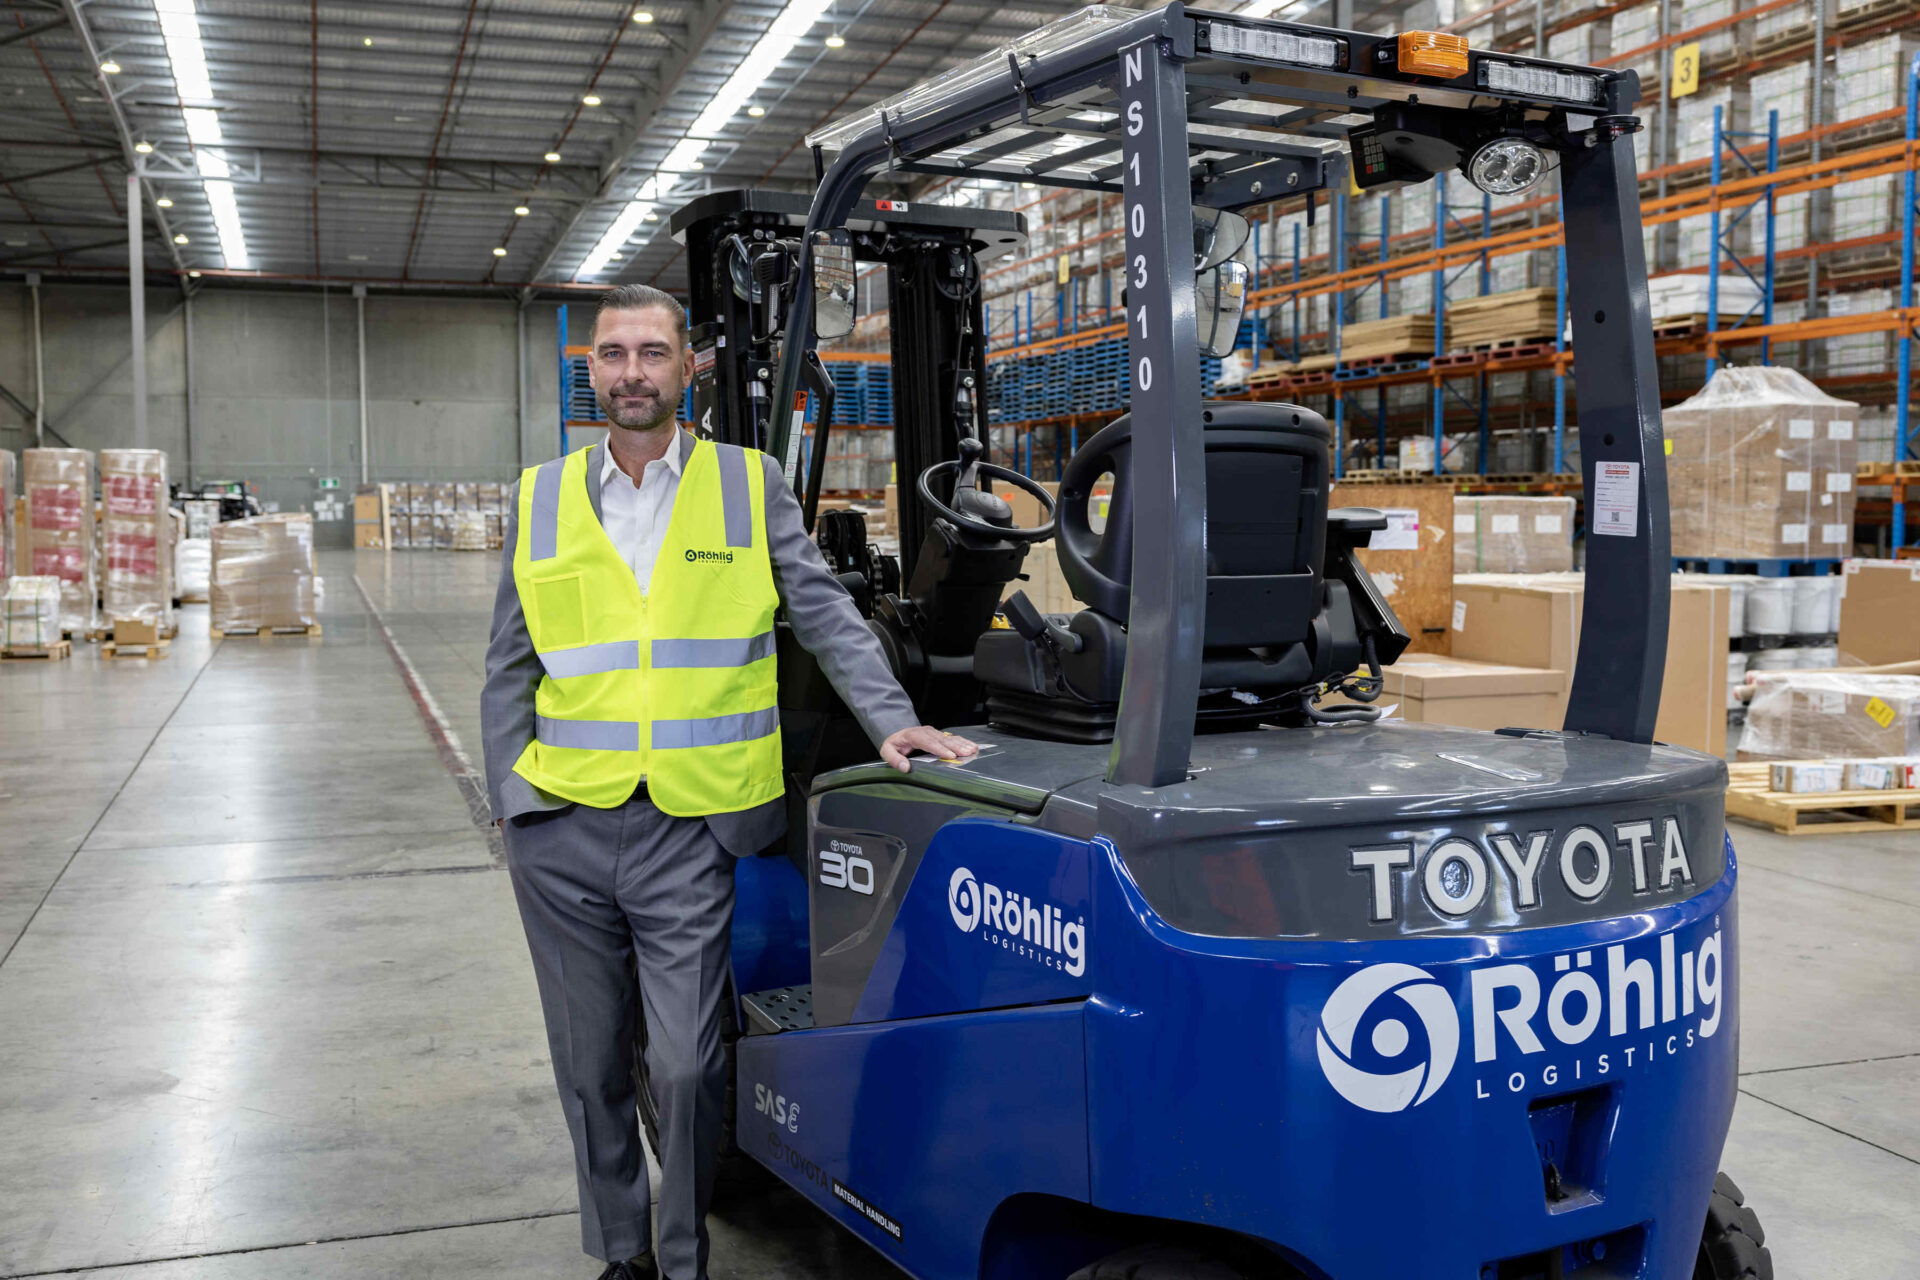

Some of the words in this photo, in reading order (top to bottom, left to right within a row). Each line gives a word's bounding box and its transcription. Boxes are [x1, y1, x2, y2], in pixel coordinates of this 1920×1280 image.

[1680, 57, 1692, 83] 3
[1125, 47, 1153, 392] NS10310
[698, 550, 733, 564] Röhlig
[839, 842, 863, 856] TOYOTA
[1352, 818, 1693, 922] TOYOTA
[819, 850, 874, 896] 30
[983, 882, 1086, 978] Röhlig
[984, 930, 1062, 971] LOGISTICS
[1477, 1028, 1694, 1099] LOGISTICS
[784, 1145, 829, 1192] TOYOTA
[834, 1183, 865, 1213] MATERIAL
[865, 1205, 901, 1237] HANDLING
